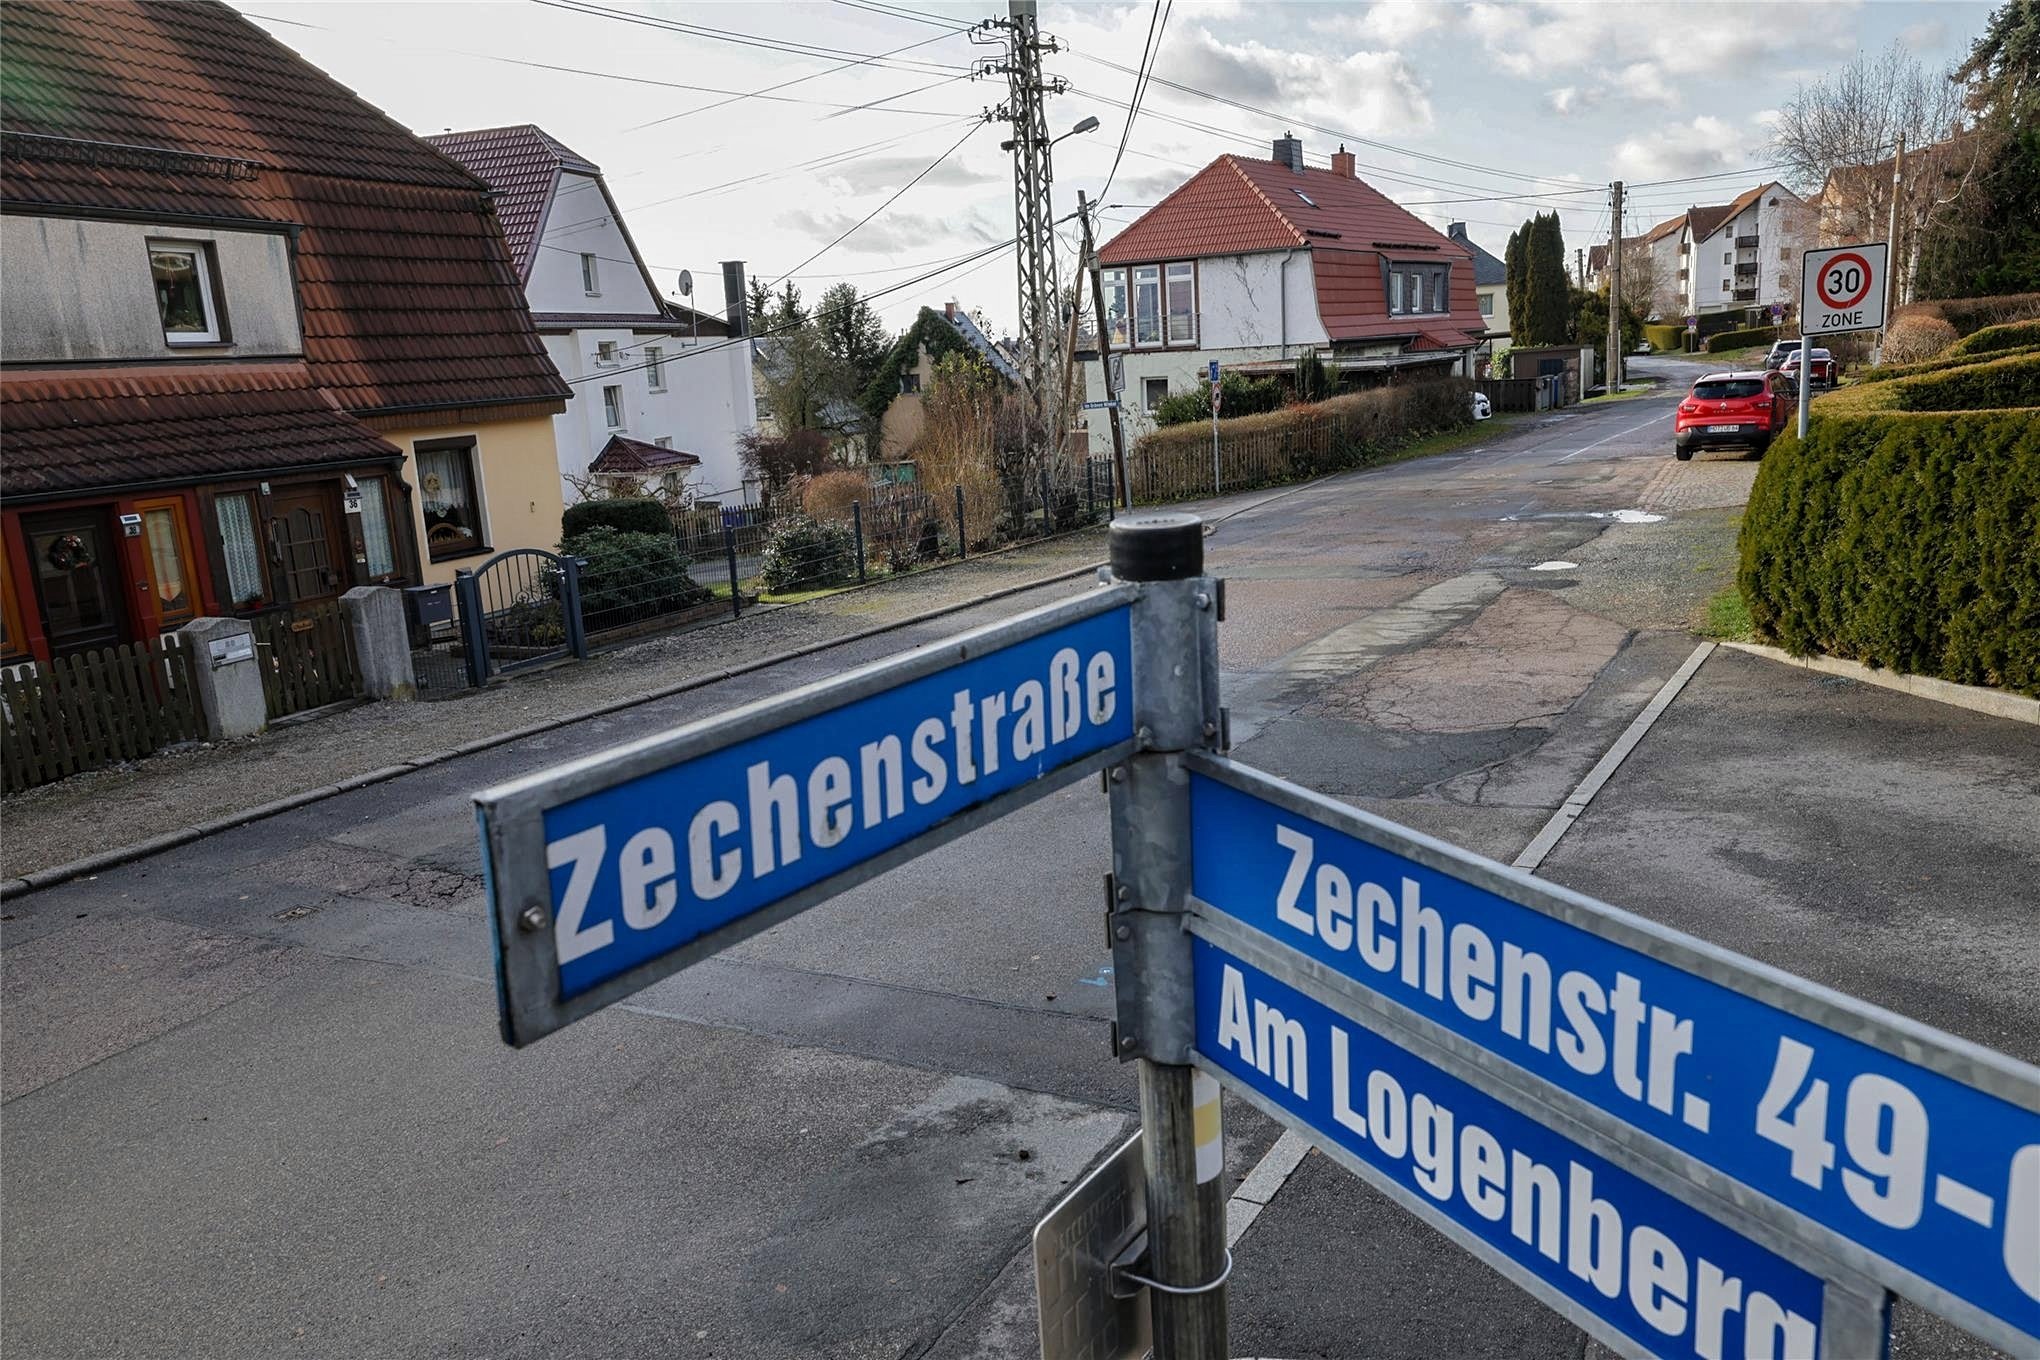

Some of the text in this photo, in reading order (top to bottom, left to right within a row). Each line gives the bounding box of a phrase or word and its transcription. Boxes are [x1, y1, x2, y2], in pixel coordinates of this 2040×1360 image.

[1822, 311, 1863, 328] ZONE
[1828, 267, 1860, 295] 30
[349, 499, 358, 508] 36
[546, 646, 1116, 966] Zechenstraße
[1275, 823, 1711, 1134] Zechenstr.
[1217, 963, 1309, 1101] Am
